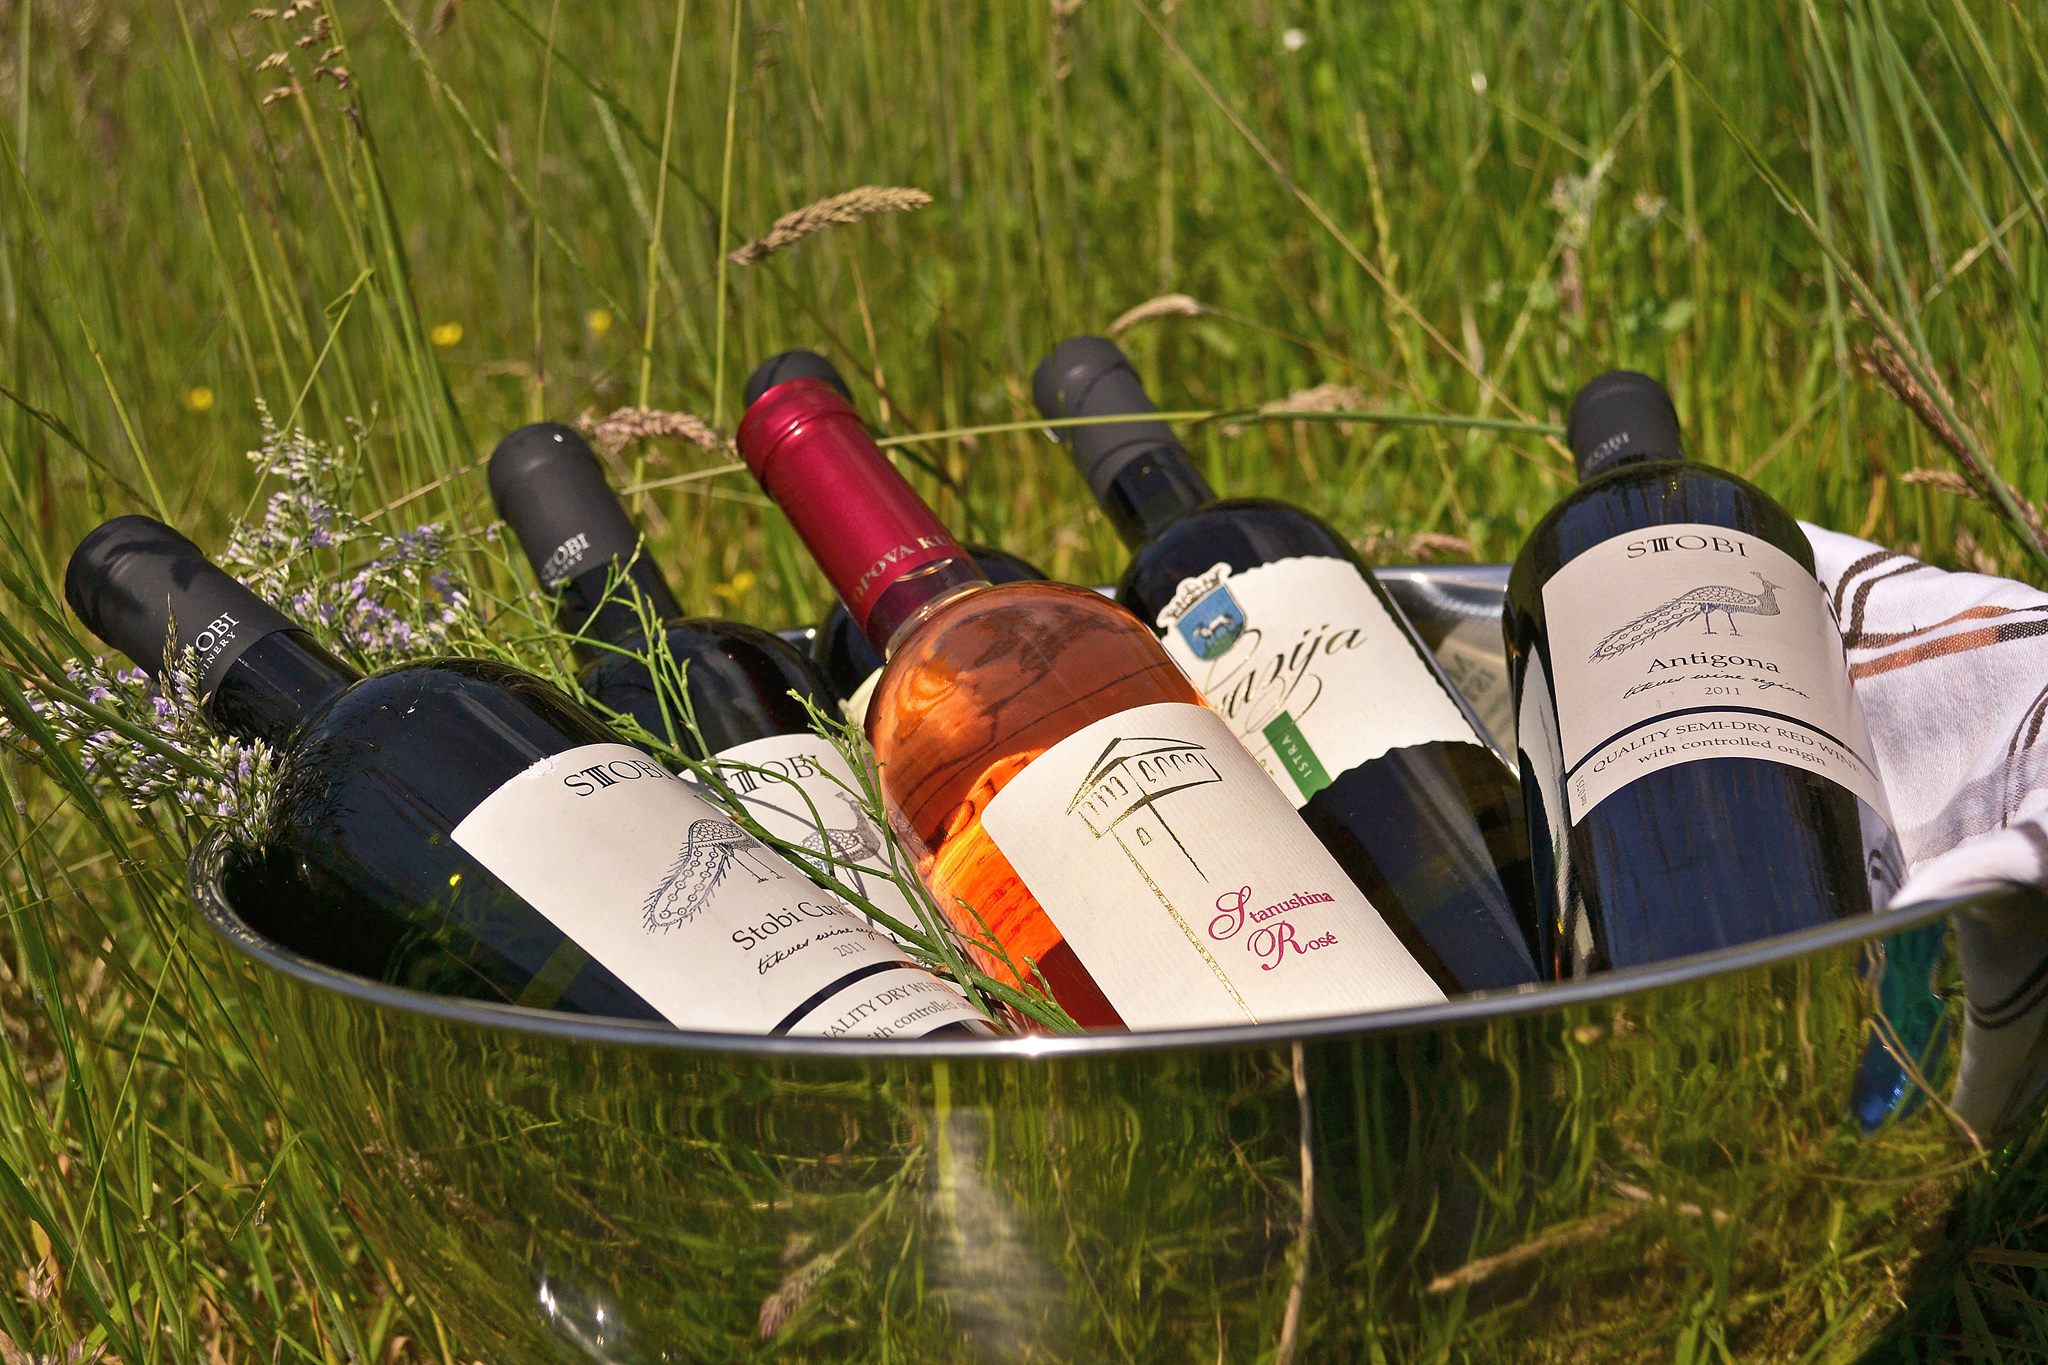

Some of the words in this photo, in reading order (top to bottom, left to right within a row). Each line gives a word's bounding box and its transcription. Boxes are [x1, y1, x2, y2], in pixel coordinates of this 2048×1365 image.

[1627, 535, 1749, 559] STOBI
[199, 631, 236, 680] WINERY
[1647, 652, 1780, 674] Antigona
[1212, 624, 1367, 734] azija
[1692, 671, 1744, 680] wine
[1751, 677, 1810, 699] region
[1704, 686, 1741, 695] 2011
[1281, 733, 1313, 778] ISTRA
[1593, 727, 1671, 773] QUALITY
[1675, 721, 1771, 735] SEMI-DRY
[1776, 727, 1814, 746] RED
[1817, 741, 1862, 776] WINE
[1637, 742, 1676, 764] with
[1681, 737, 1772, 751] controlled
[1777, 745, 1827, 767] origin
[563, 759, 675, 797] STOBI
[731, 908, 804, 951] Stobi
[1208, 885, 1335, 941] Stanushina
[815, 924, 853, 943] wine
[833, 941, 866, 958] 2011
[1246, 919, 1338, 971] Rosé
[822, 999, 877, 1038] ALITY
[876, 985, 911, 1008] DRY
[894, 1000, 957, 1029] controlled
